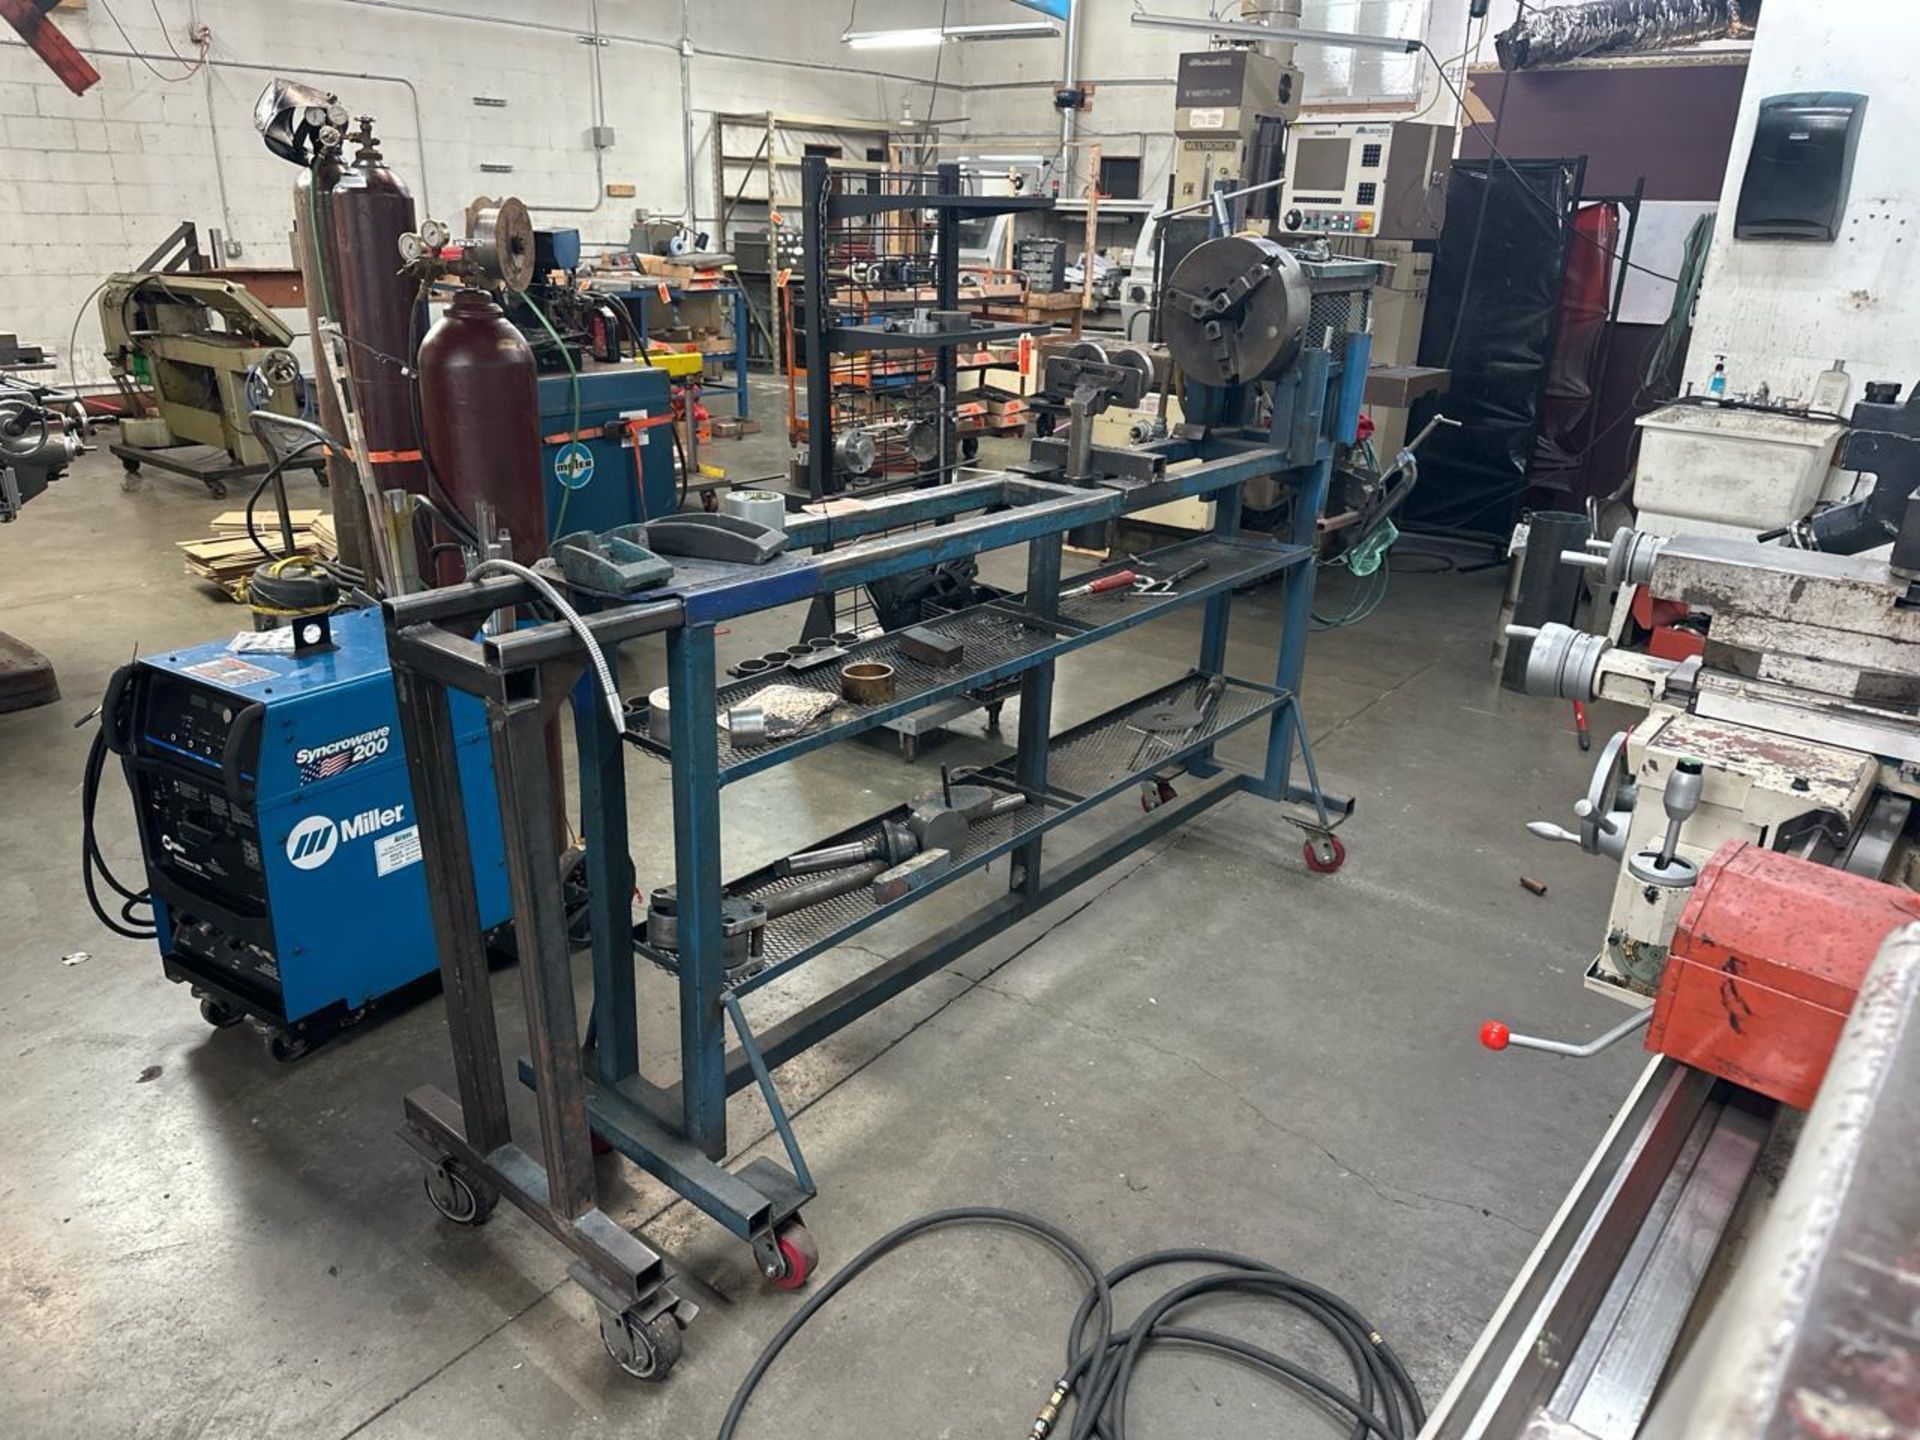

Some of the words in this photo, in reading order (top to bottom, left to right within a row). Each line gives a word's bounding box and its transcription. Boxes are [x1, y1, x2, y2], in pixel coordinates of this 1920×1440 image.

[296, 726, 390, 764] Syncrowave
[351, 738, 389, 762] 200
[340, 804, 405, 843] Miller
